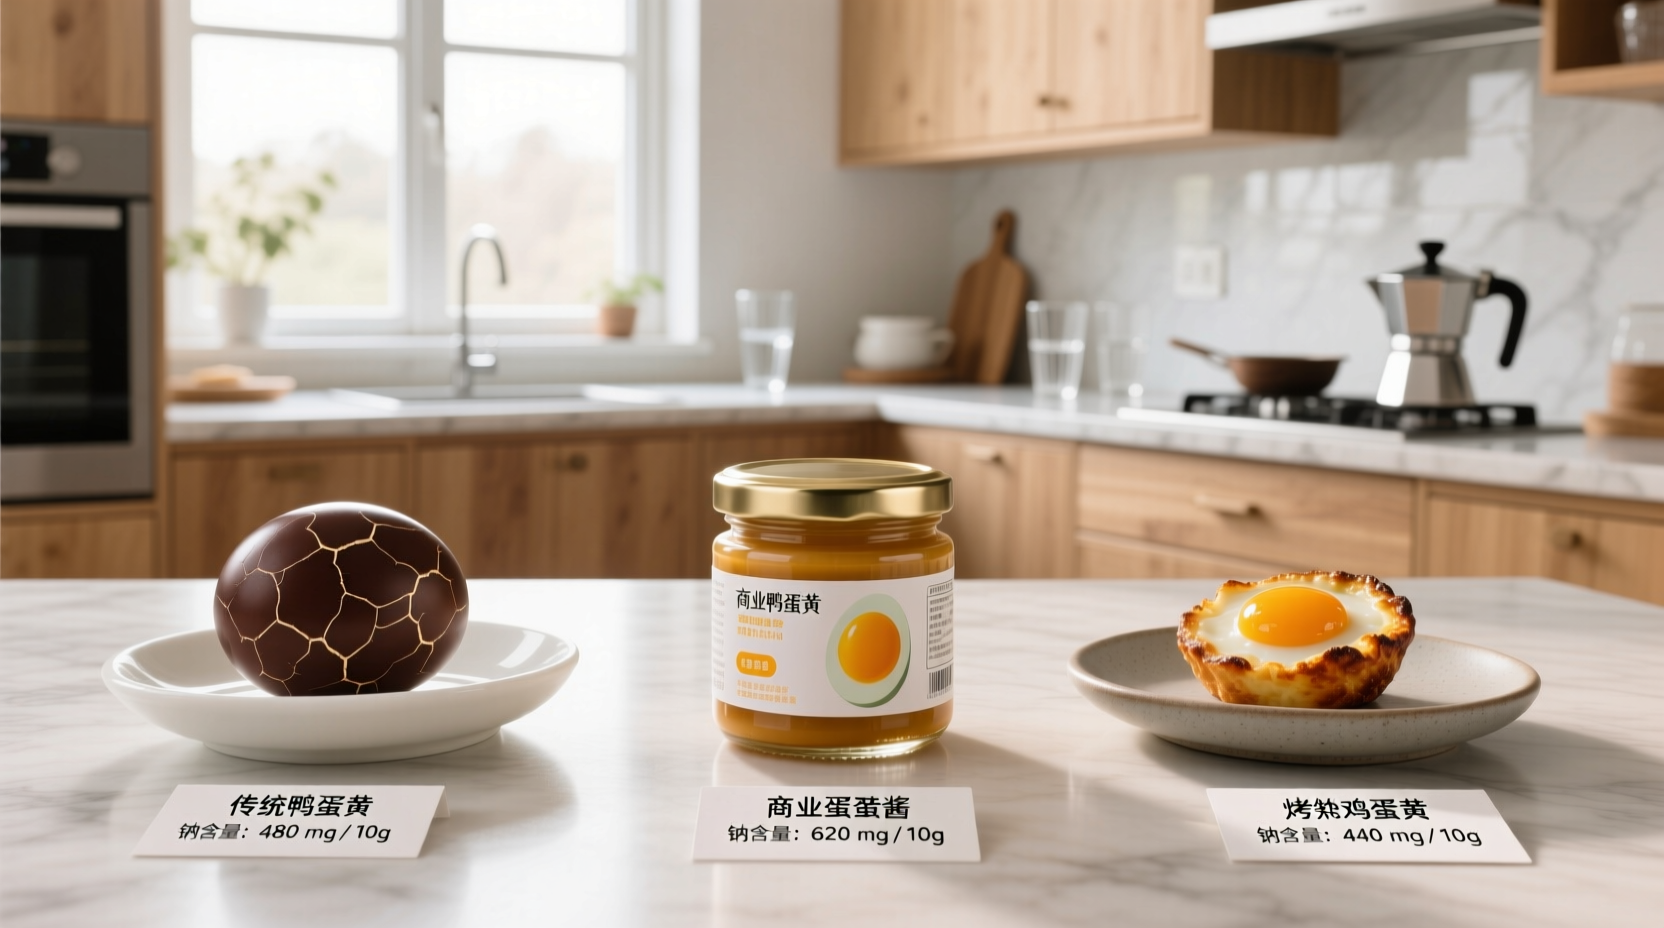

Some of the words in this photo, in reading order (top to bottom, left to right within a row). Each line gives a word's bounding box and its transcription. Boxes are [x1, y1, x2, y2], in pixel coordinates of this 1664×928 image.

[736, 588, 821, 614] 商业鸭蛋黄
[230, 794, 373, 817] 传统鸭蛋黄
